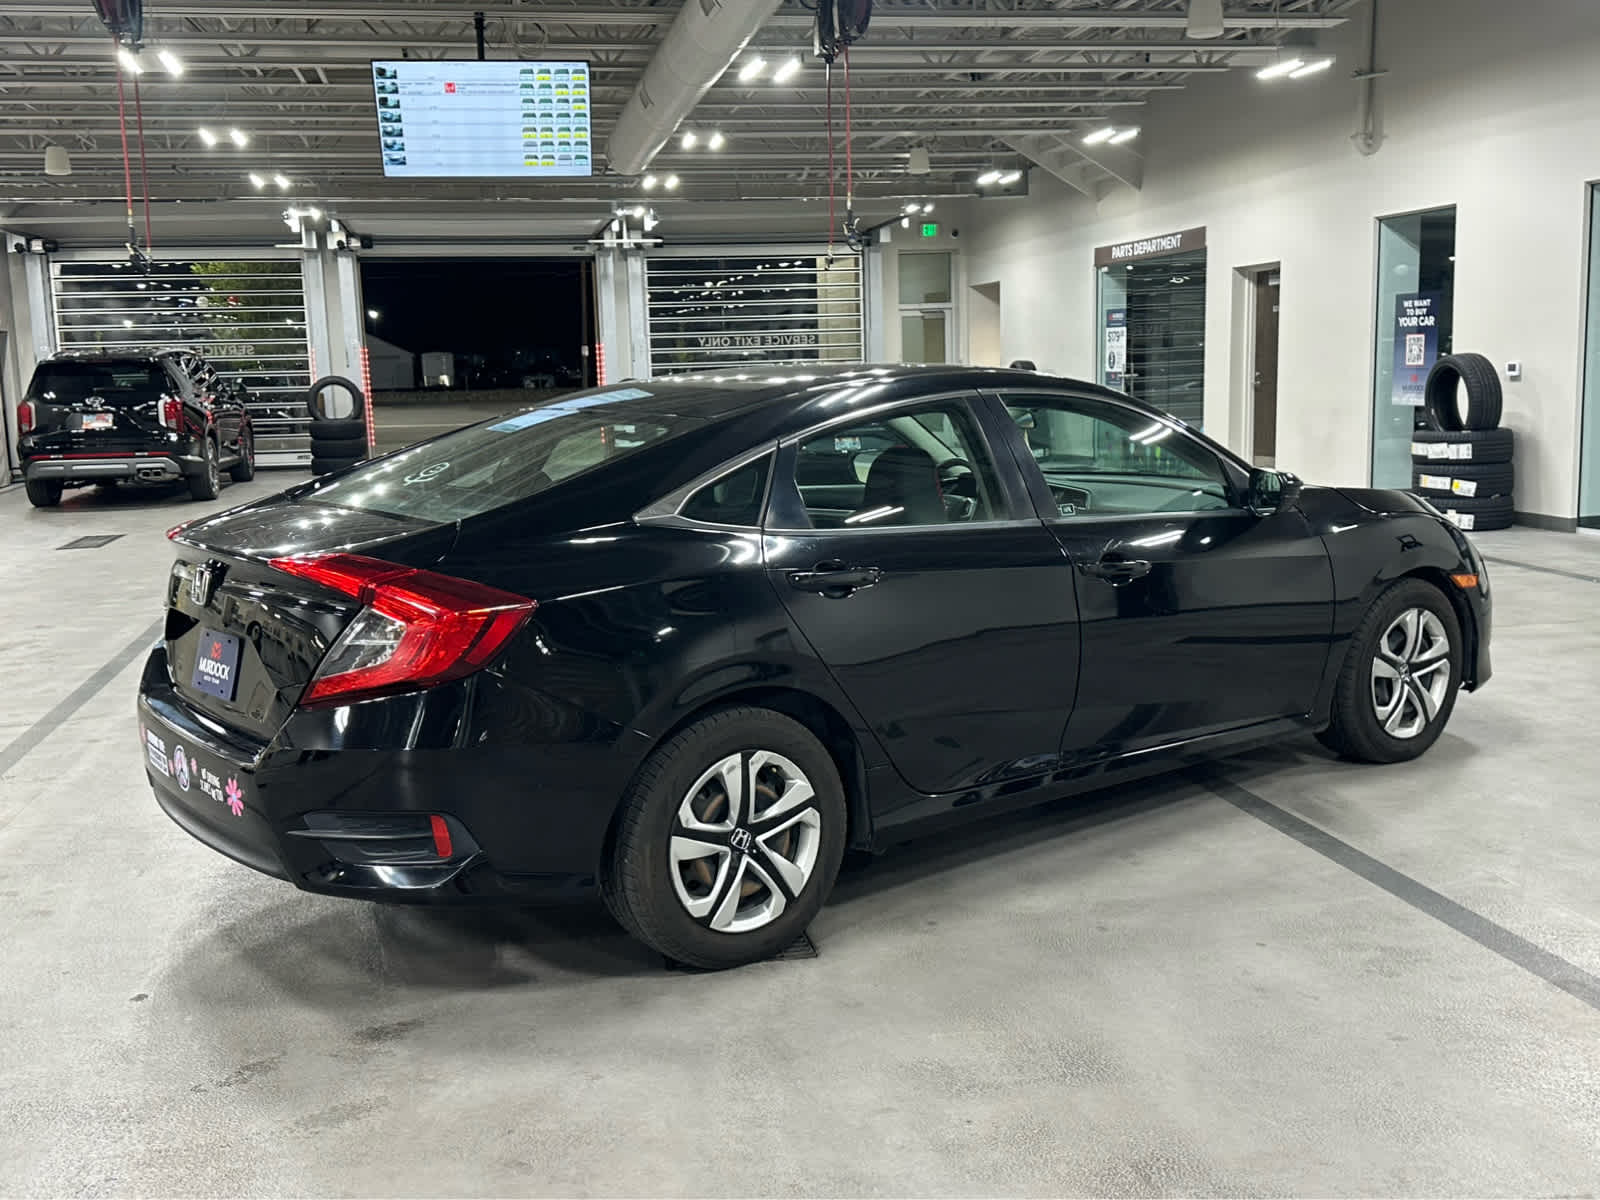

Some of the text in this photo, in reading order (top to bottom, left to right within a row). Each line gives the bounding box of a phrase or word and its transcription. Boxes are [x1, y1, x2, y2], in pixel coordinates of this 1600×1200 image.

[1111, 234, 1182, 259] PARTS DEPARTMENT
[1403, 299, 1431, 308] WE WANT
[1406, 308, 1414, 316] TO
[1398, 316, 1435, 327] YOUR CAR
[198, 656, 230, 681] MURDOCK
